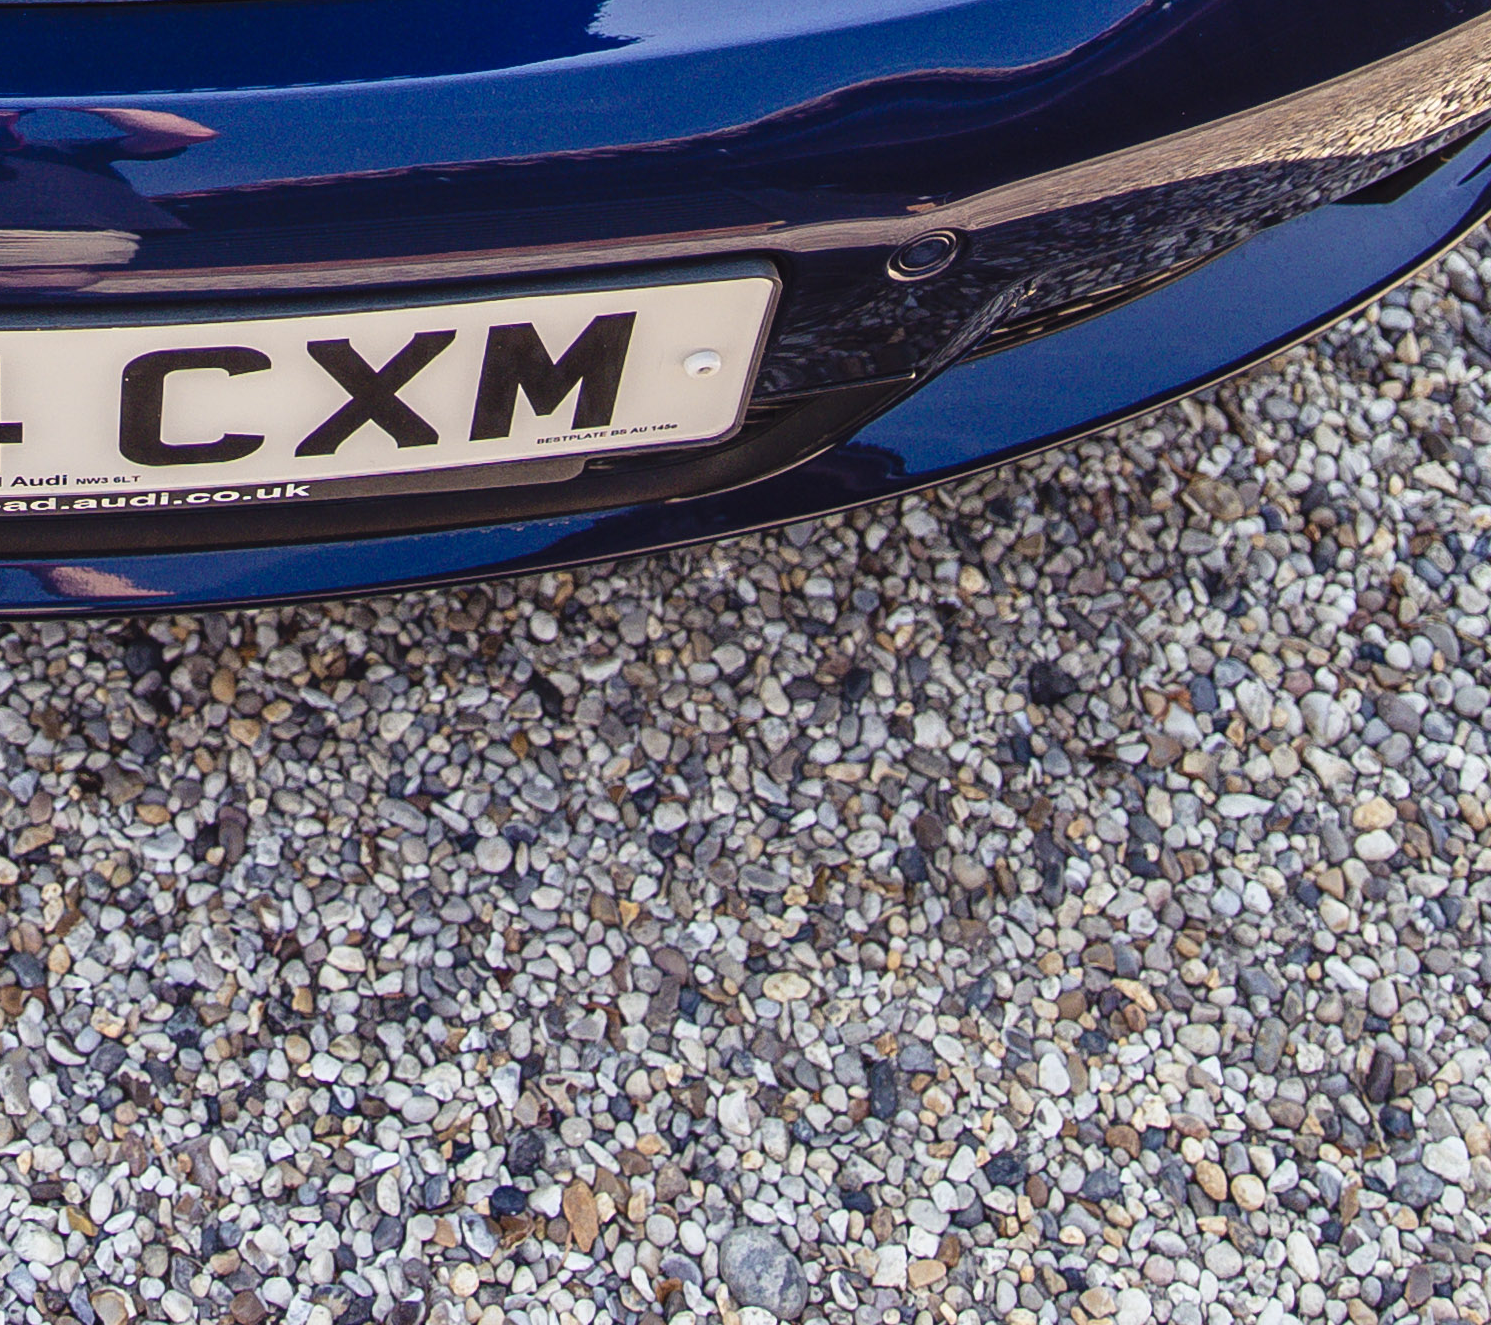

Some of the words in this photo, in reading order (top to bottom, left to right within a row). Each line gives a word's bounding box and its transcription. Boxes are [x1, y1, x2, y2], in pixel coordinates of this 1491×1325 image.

[118, 311, 637, 468] CXM
[537, 431, 608, 444] BESTPLATE
[10, 474, 68, 487] Audi
[76, 477, 109, 486] NW3
[113, 475, 141, 484] 6LT
